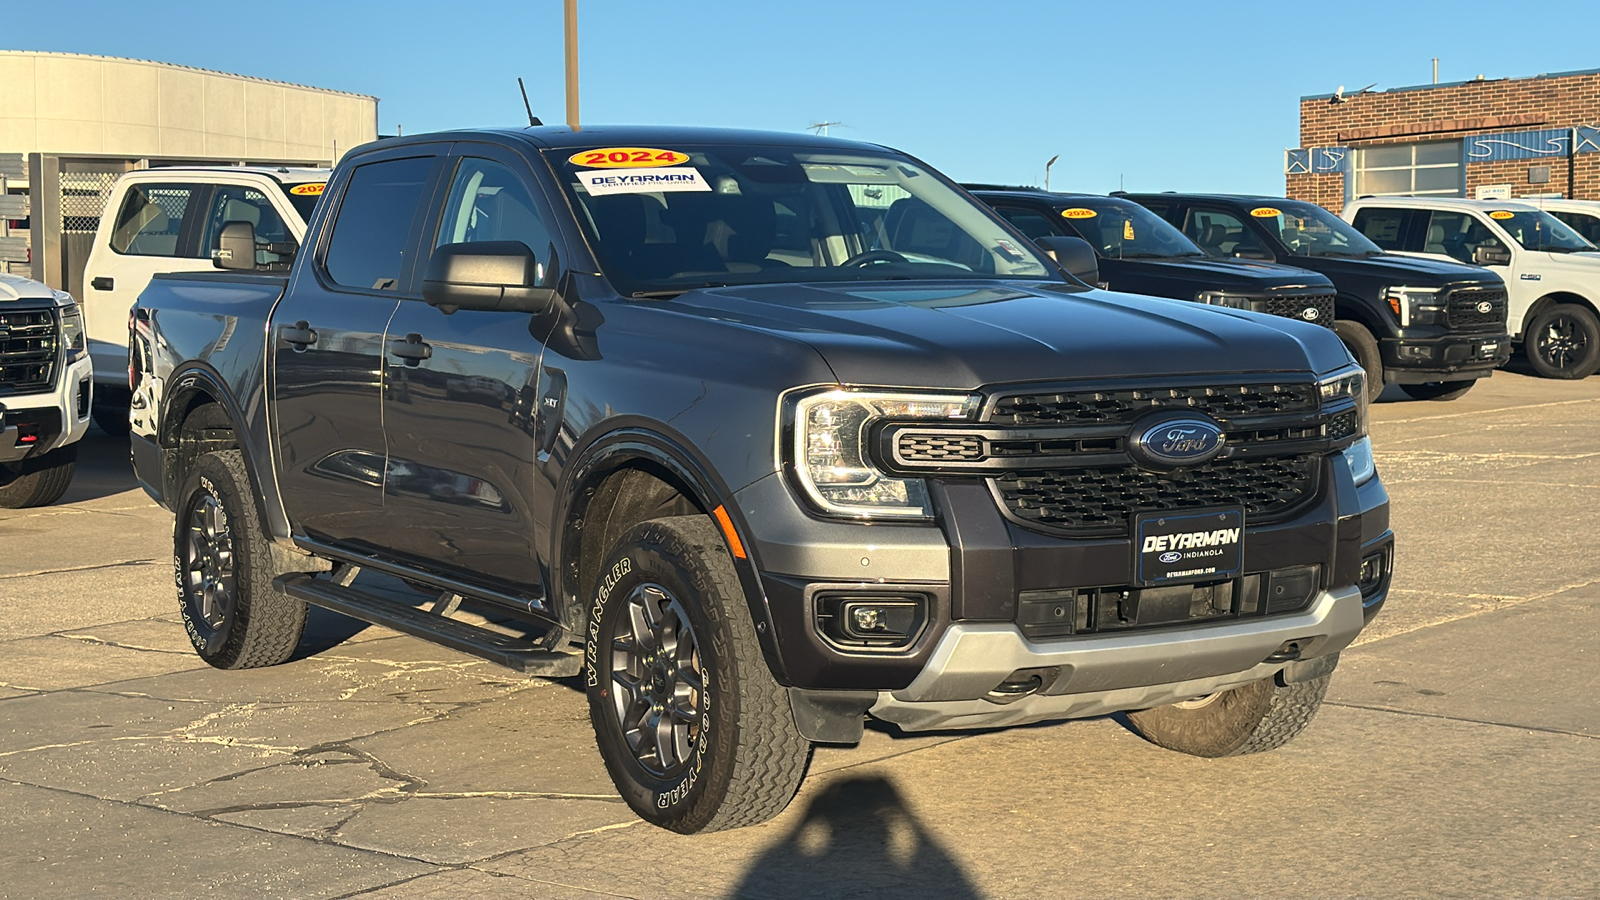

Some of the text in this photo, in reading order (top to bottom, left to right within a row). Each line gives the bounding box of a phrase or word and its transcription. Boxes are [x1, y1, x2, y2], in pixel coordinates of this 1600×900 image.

[1339, 113, 1546, 141] SOFT CLOTH TIDY WASH
[585, 151, 678, 165] 2024
[591, 174, 695, 185] DEYARMAN
[601, 180, 646, 188] CERTIFIED
[297, 184, 326, 194] 202
[544, 397, 559, 408] XLT
[1162, 429, 1207, 453] Ford
[1141, 527, 1241, 553] DEYARMAN
[1162, 548, 1224, 562] Ford INDIANOLA
[586, 557, 632, 687] WRANGLER
[657, 667, 711, 809] GOODYEAR
